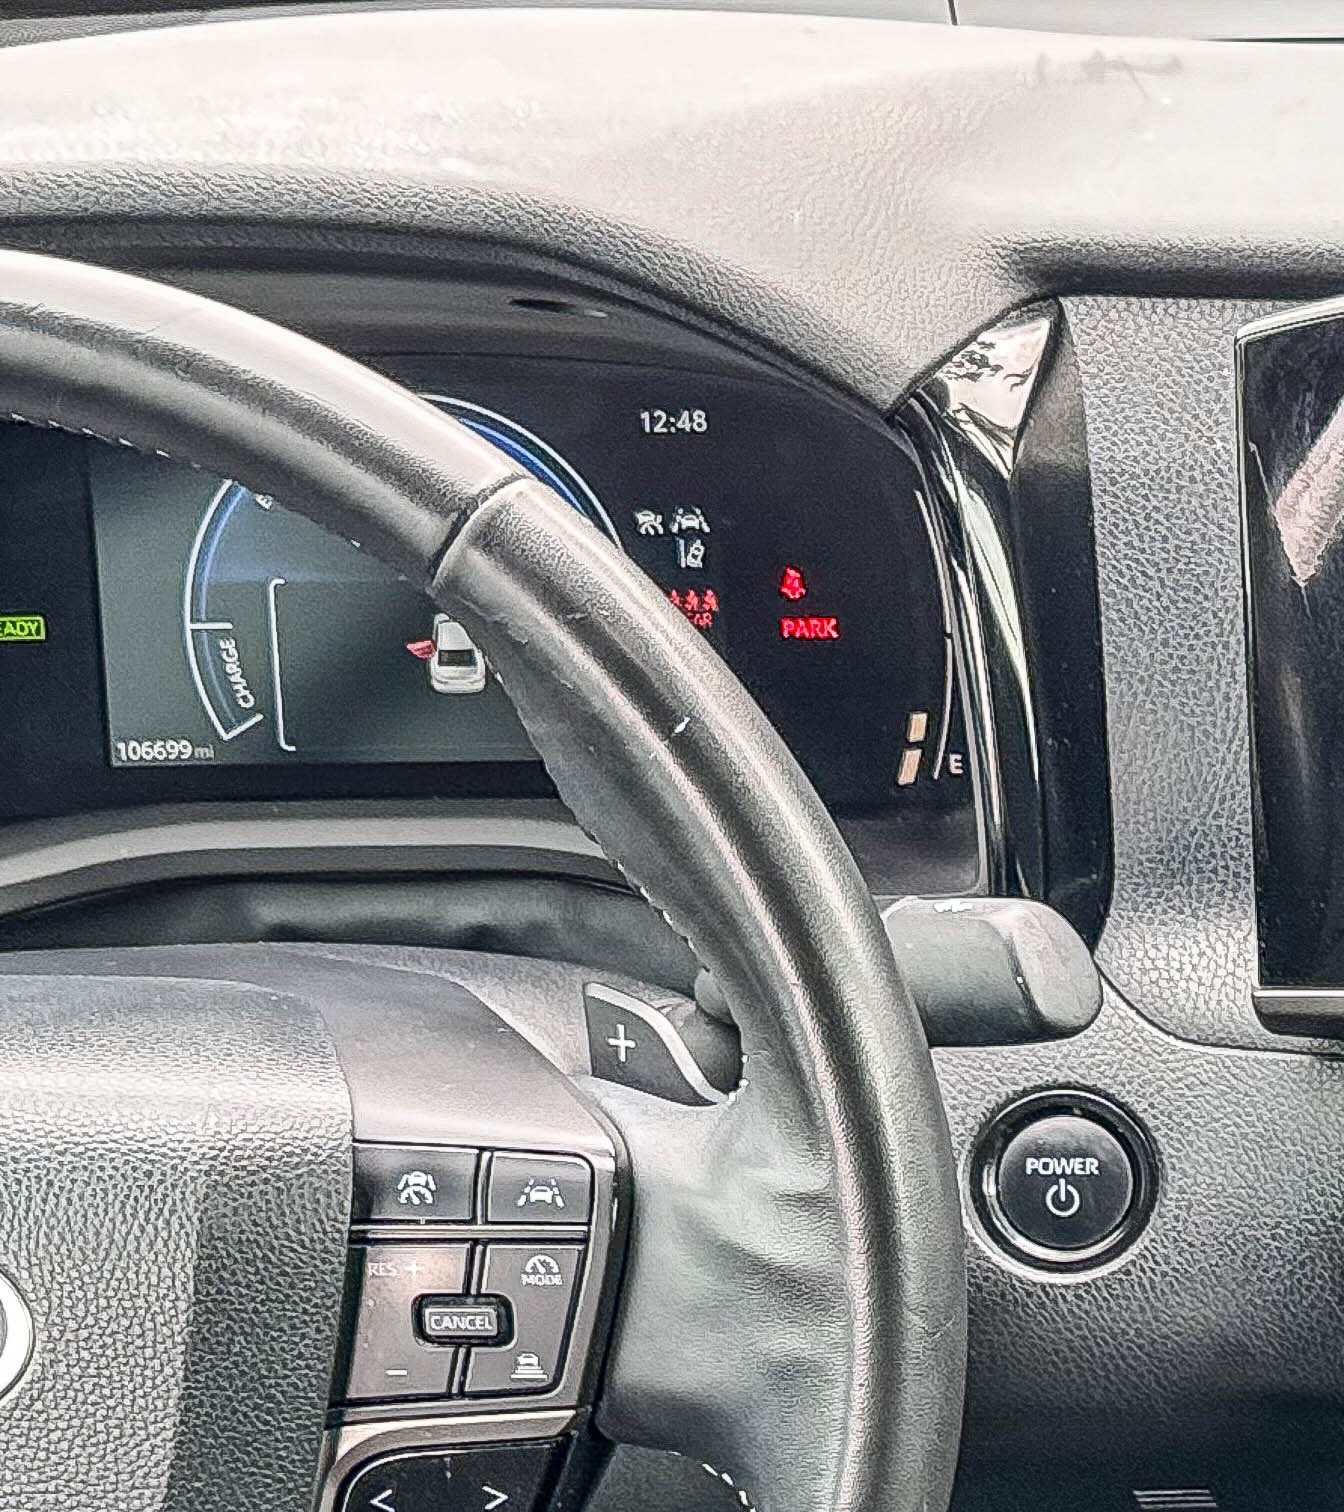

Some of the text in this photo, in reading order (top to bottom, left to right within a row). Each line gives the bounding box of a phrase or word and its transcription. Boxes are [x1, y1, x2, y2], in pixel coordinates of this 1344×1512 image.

[640, 410, 708, 433] 12:48
[781, 617, 840, 638] PARK
[219, 637, 255, 709] CHARGE
[116, 740, 194, 761] 106699
[949, 754, 964, 774] E
[1025, 1157, 1099, 1177] POWER
[369, 1262, 398, 1277] RES
[521, 1274, 564, 1287] MODE
[430, 1315, 494, 1330] CANCEL
